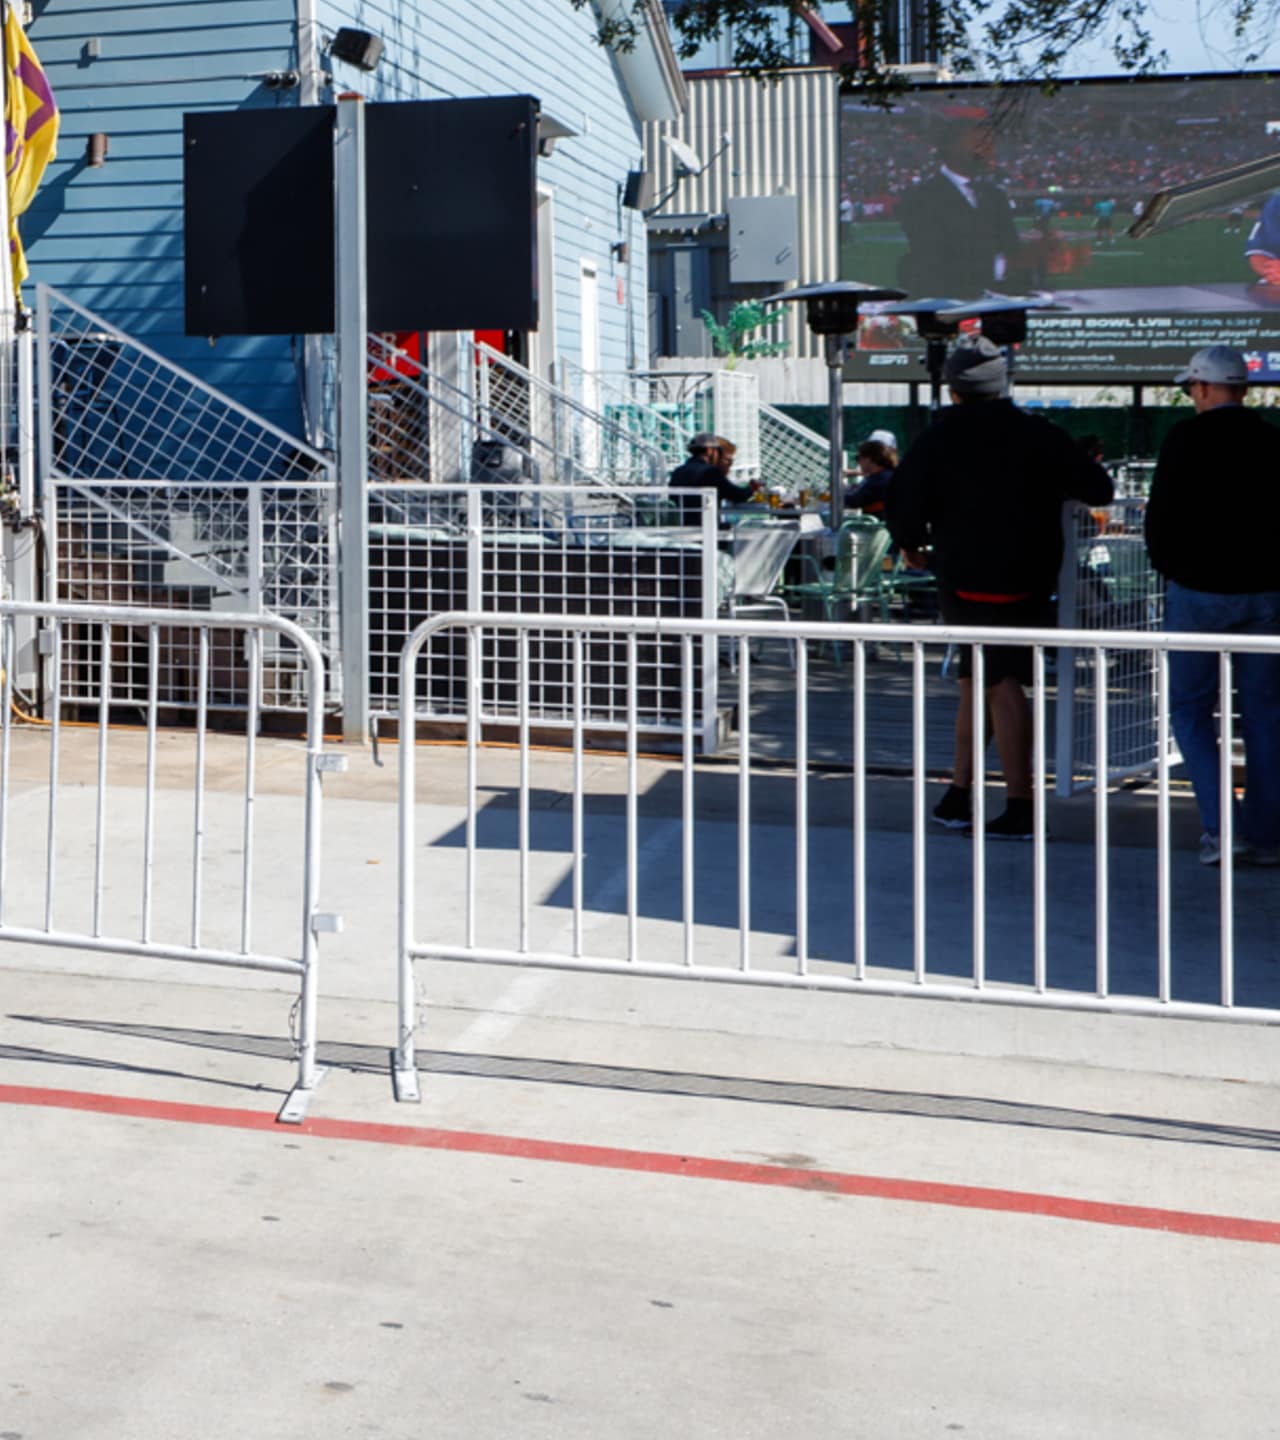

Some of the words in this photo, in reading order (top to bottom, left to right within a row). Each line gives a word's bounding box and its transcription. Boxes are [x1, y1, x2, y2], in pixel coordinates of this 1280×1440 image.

[1026, 317, 1082, 329] SUPER
[1084, 317, 1135, 329] BOWL
[1035, 330, 1072, 339] Patrick
[1218, 328, 1258, 340] playoff
[868, 354, 909, 366] ESPN
